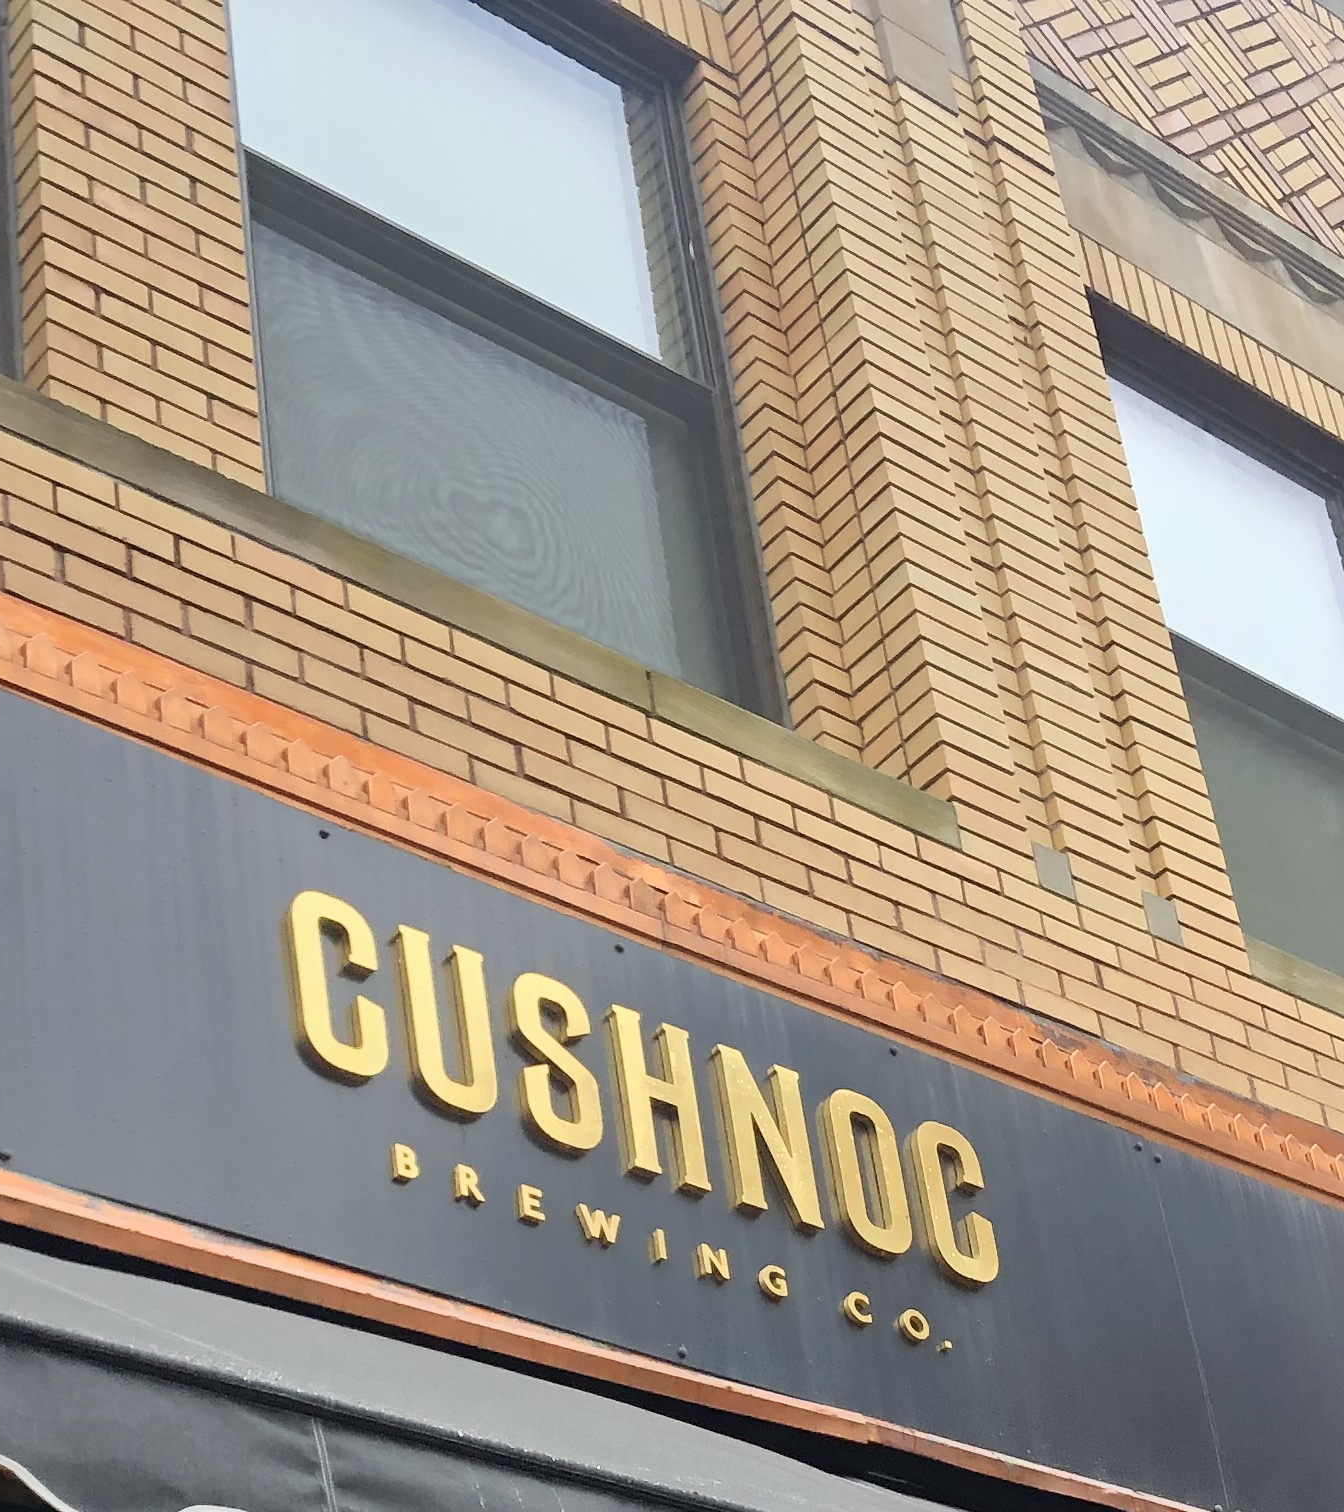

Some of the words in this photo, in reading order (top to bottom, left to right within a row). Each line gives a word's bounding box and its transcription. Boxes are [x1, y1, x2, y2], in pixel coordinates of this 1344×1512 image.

[287, 889, 1000, 1285] CUSHNOC
[390, 1142, 790, 1300] BREWING
[842, 1291, 954, 1354] CO.
